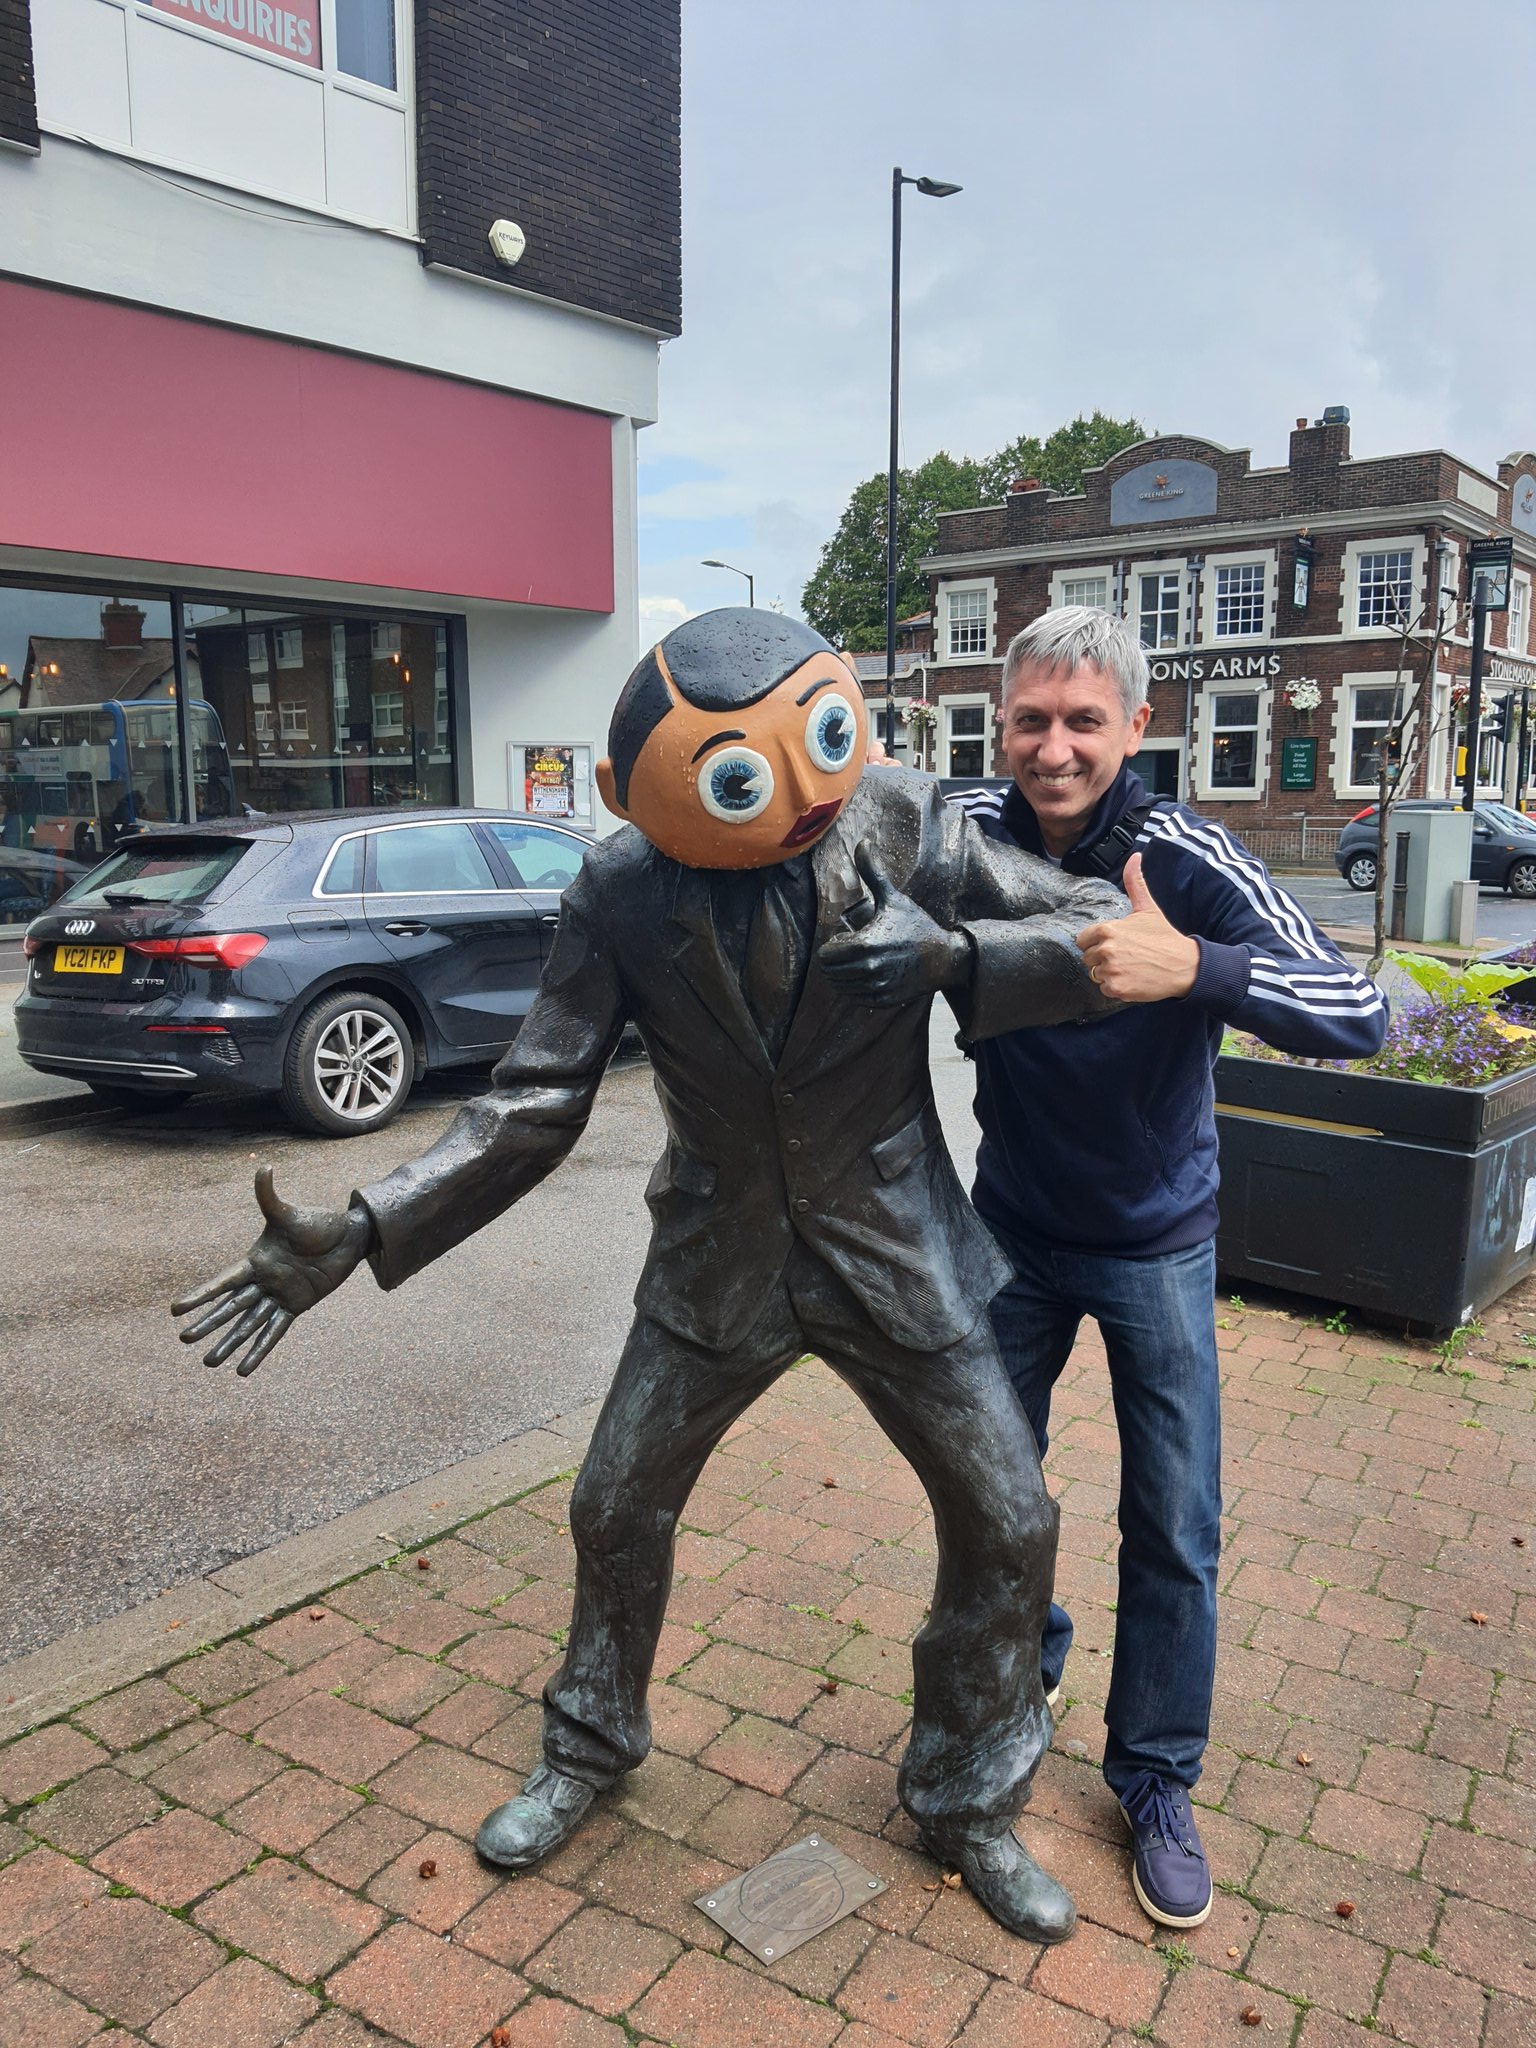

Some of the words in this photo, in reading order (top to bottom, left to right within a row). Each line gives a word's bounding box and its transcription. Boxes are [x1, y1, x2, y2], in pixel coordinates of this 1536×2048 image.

[168, 0, 312, 56] QUIRIES
[1139, 490, 1165, 500] GREENE
[1166, 488, 1184, 497] KING
[1473, 541, 1495, 549] GREENE
[1210, 655, 1281, 678] ARMS
[534, 763, 565, 772] CIRCUS
[535, 799, 542, 807] 7
[63, 947, 90, 969] YC21
[90, 948, 117, 969] FKP
